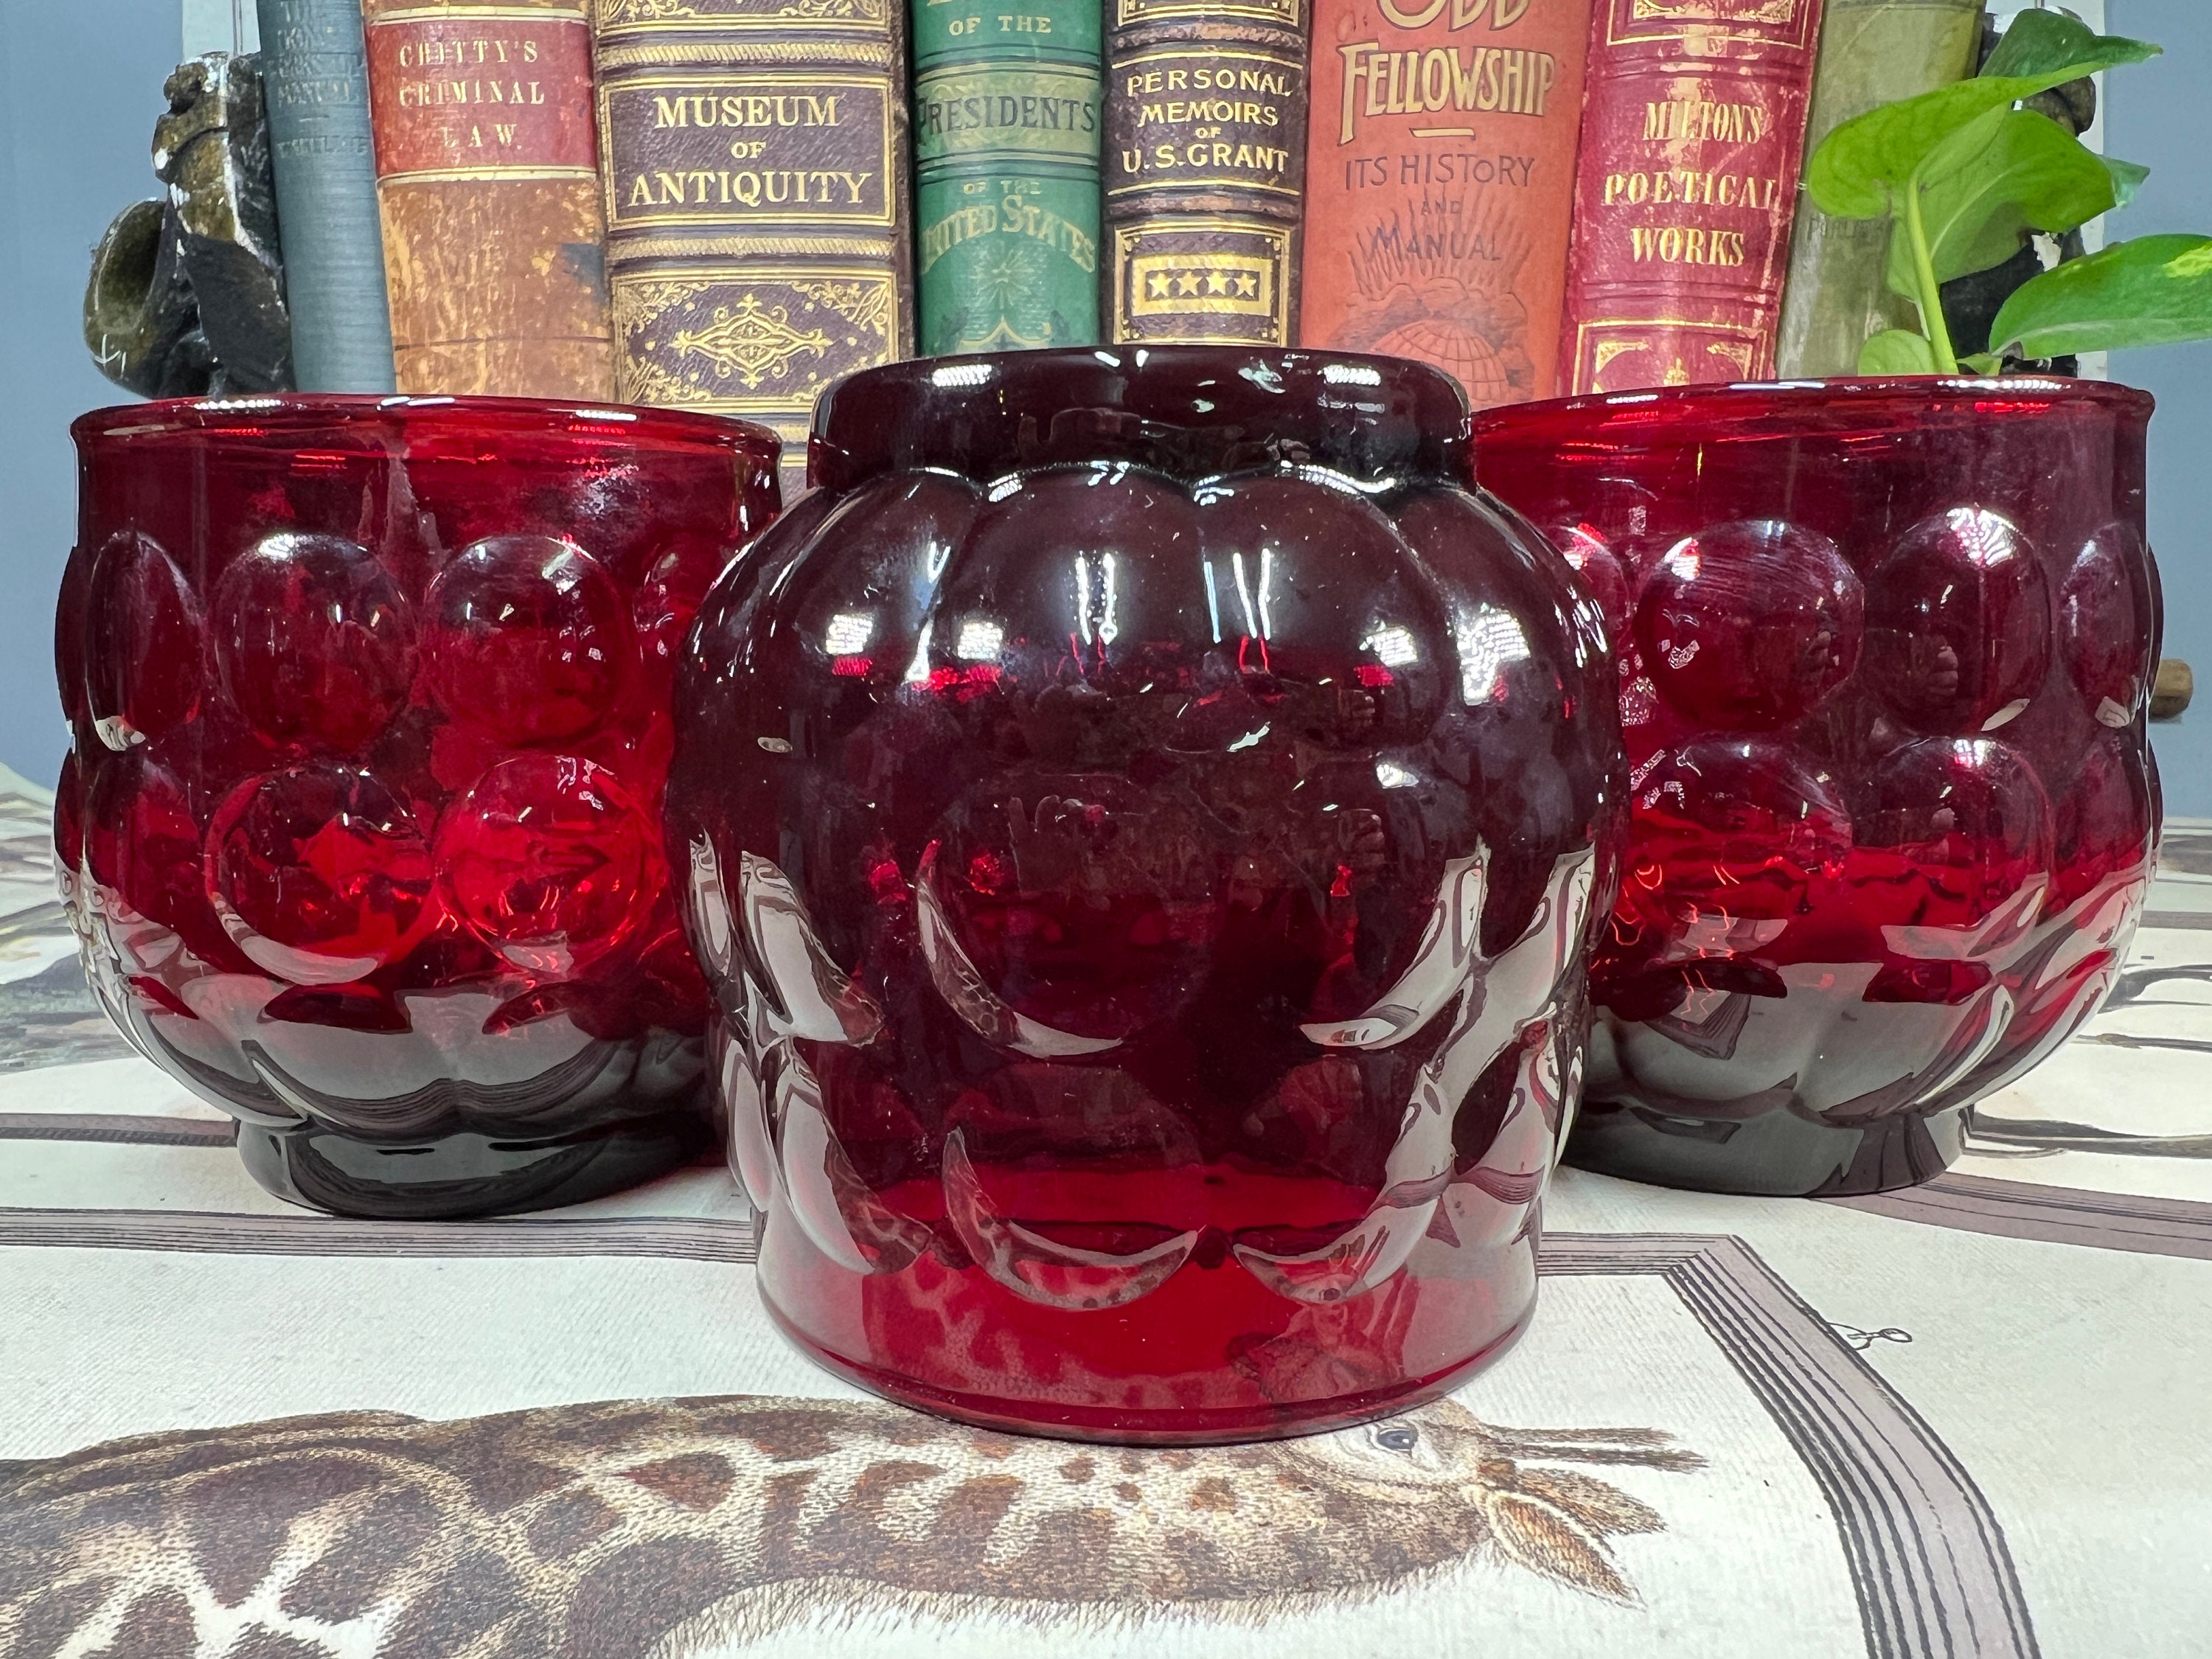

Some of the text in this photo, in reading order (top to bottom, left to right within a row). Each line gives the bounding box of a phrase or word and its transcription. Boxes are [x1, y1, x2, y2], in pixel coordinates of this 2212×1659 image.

[949, 15, 1052, 35] OF THE
[399, 79, 545, 107] CRIMINAL
[1127, 69, 1293, 97] PERSONAL
[1336, 38, 1556, 147] FELLOWSHIP
[652, 95, 841, 129] MUSEUM
[1137, 100, 1279, 128] MEMOIRS
[1194, 127, 1222, 139] OF
[730, 140, 767, 159] OF
[1345, 153, 1535, 190] ITS HISTORY
[627, 170, 873, 207] ANTIQUITY
[1421, 200, 1464, 216] AND
[921, 205, 996, 275] NITED
[1369, 226, 1502, 261] MANUAL
[1630, 227, 1745, 266] WORKS
